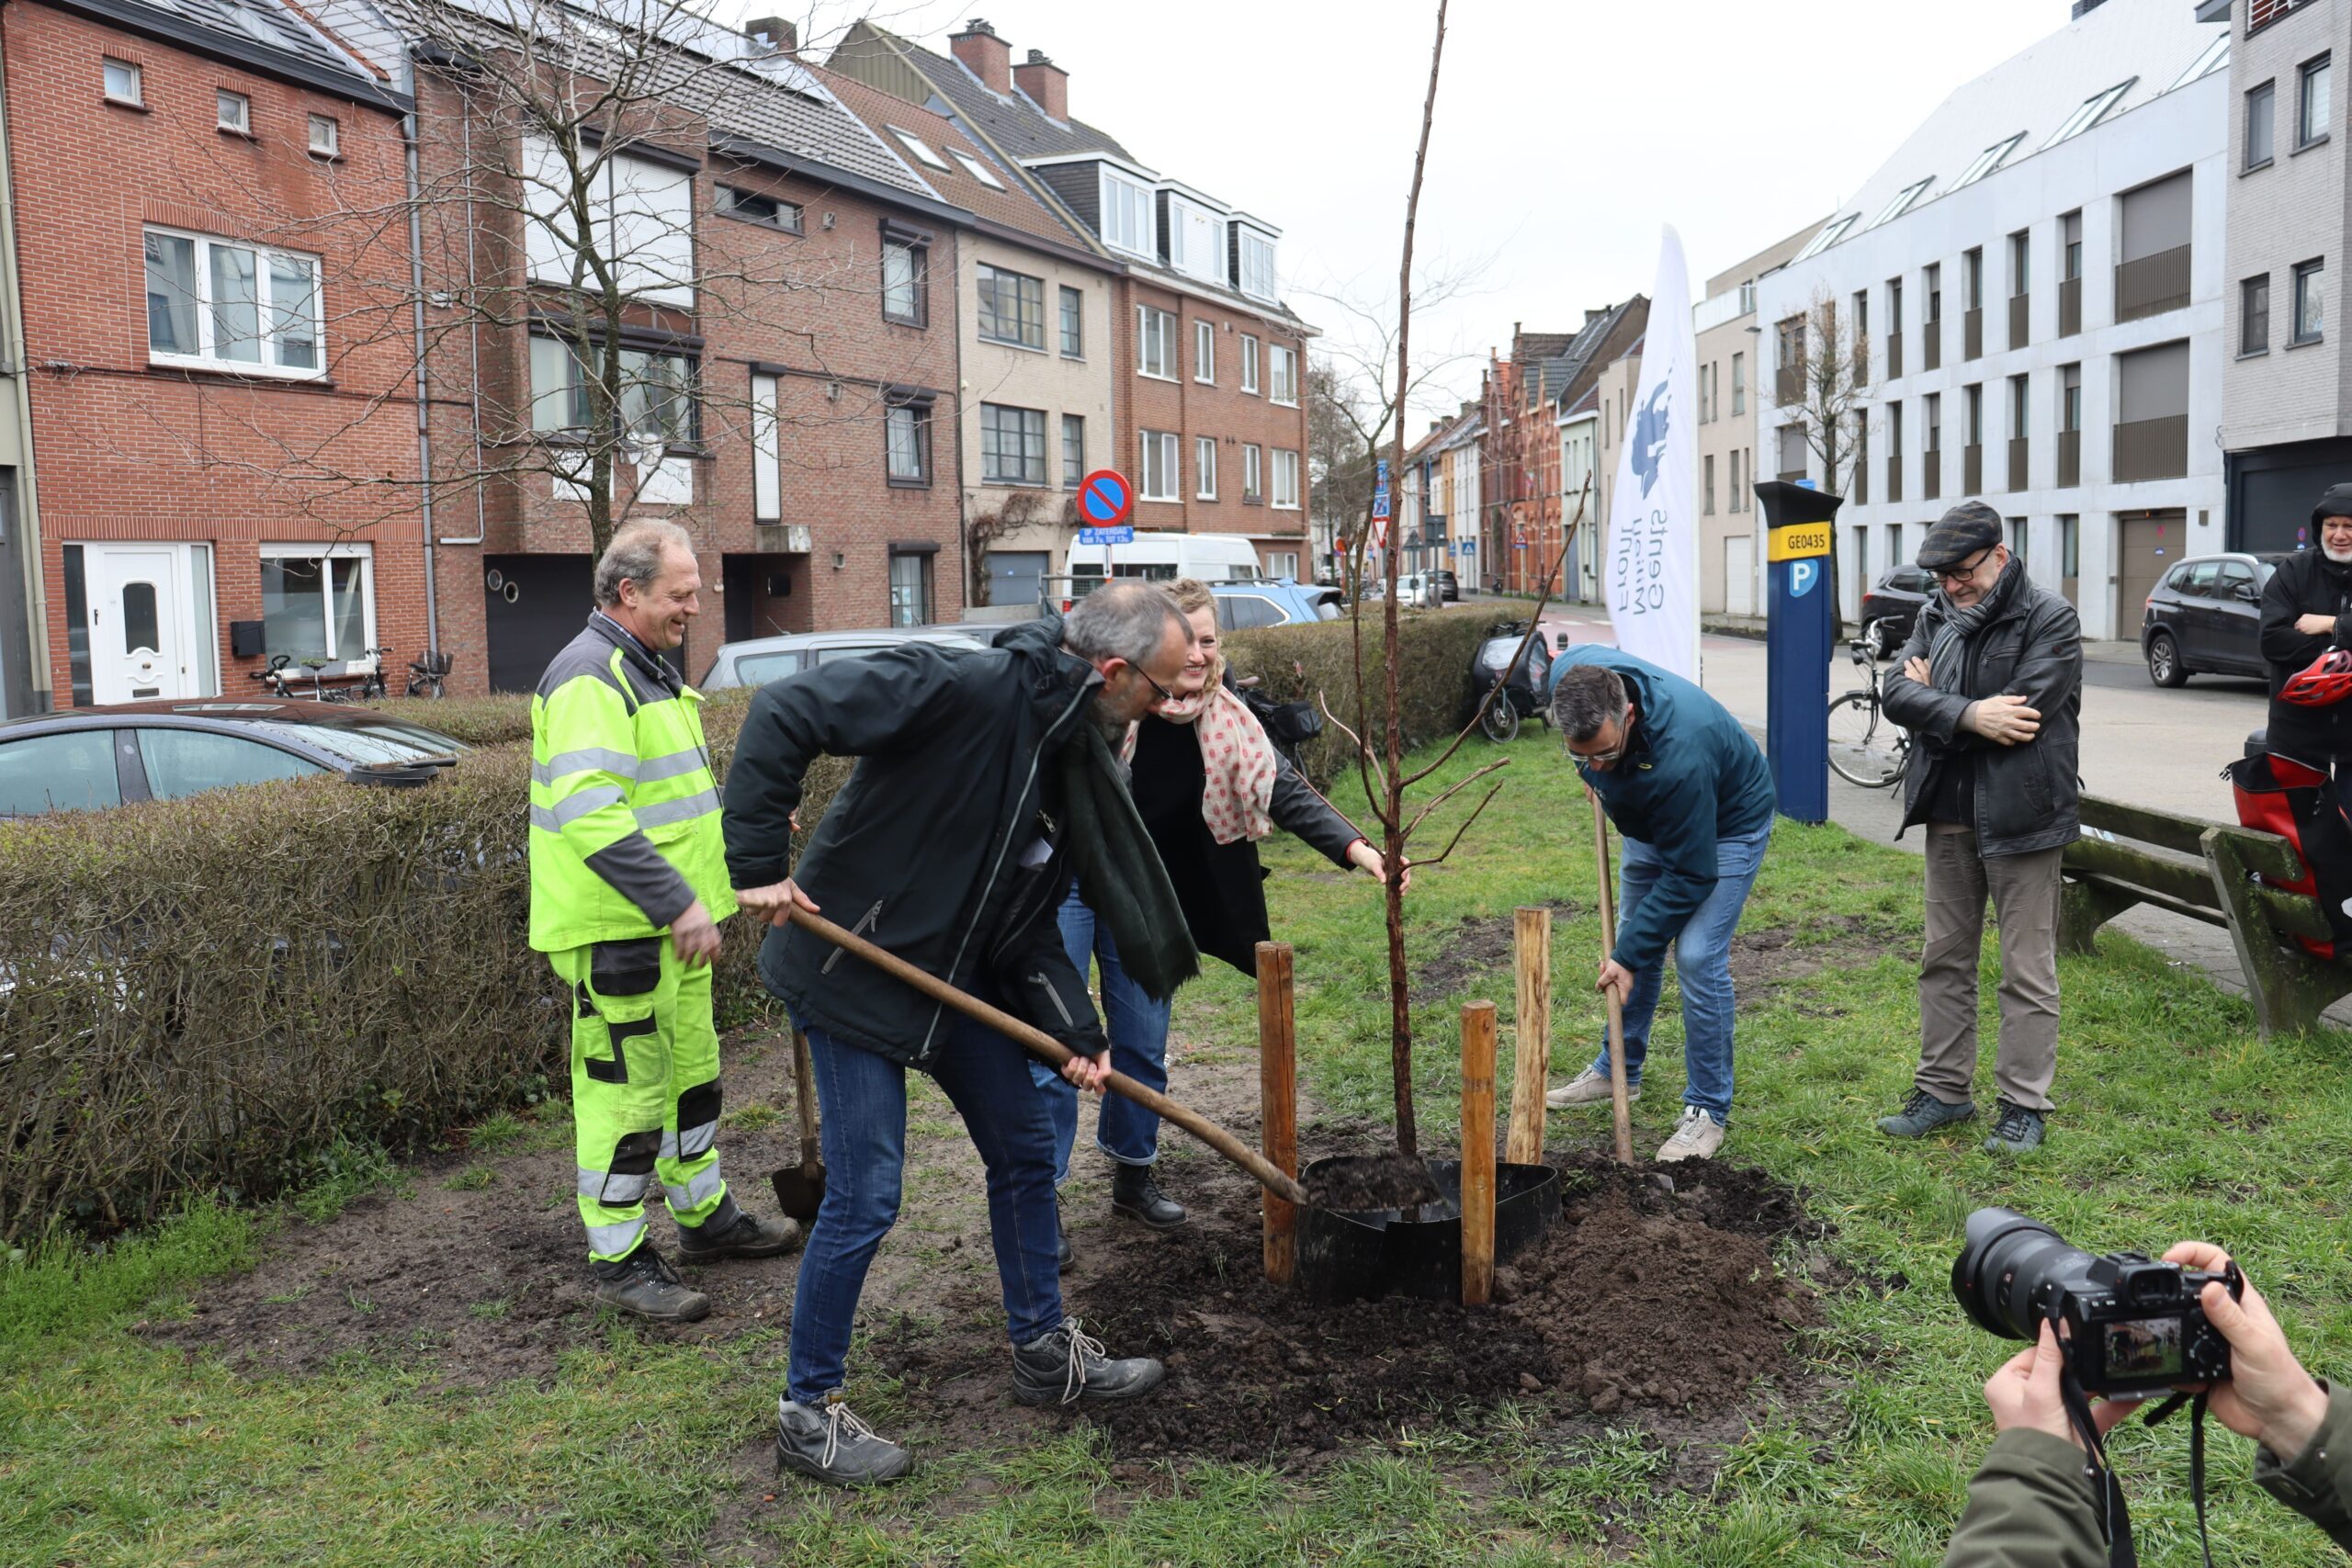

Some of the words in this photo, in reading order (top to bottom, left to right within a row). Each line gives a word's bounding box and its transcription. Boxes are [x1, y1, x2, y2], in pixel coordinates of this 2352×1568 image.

[1094, 527, 1127, 536] ZATERDAG
[1788, 534, 1826, 549] GE0435
[1793, 563, 1811, 591] P
